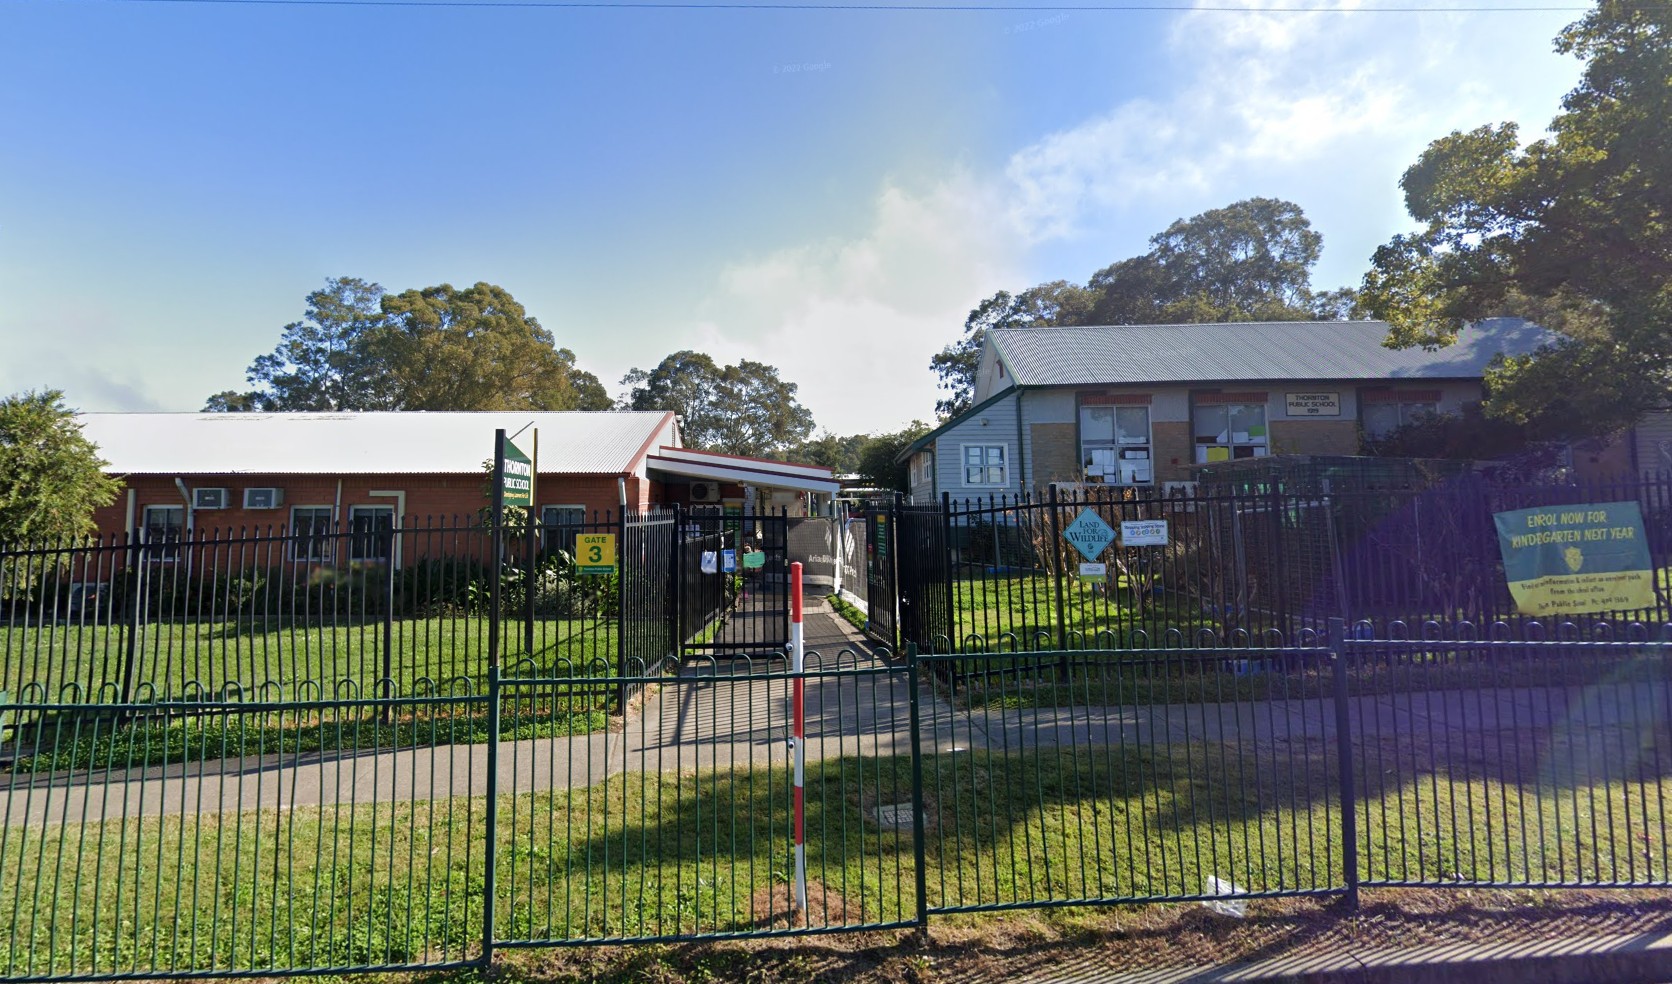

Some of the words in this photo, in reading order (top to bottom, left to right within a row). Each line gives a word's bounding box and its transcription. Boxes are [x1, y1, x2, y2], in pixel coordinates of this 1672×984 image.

[504, 458, 531, 477] THORNTON
[516, 479, 529, 491] SCHOOL
[1079, 520, 1100, 529] LAND
[1527, 513, 1557, 528] ENROL
[1560, 511, 1585, 525] NOW
[1587, 510, 1607, 523] FOR
[584, 536, 607, 544] GATE
[1069, 531, 1109, 542] WILDLIFE
[1584, 528, 1608, 541] NEXT
[1610, 526, 1635, 540] YEAR
[588, 545, 603, 563] 3
